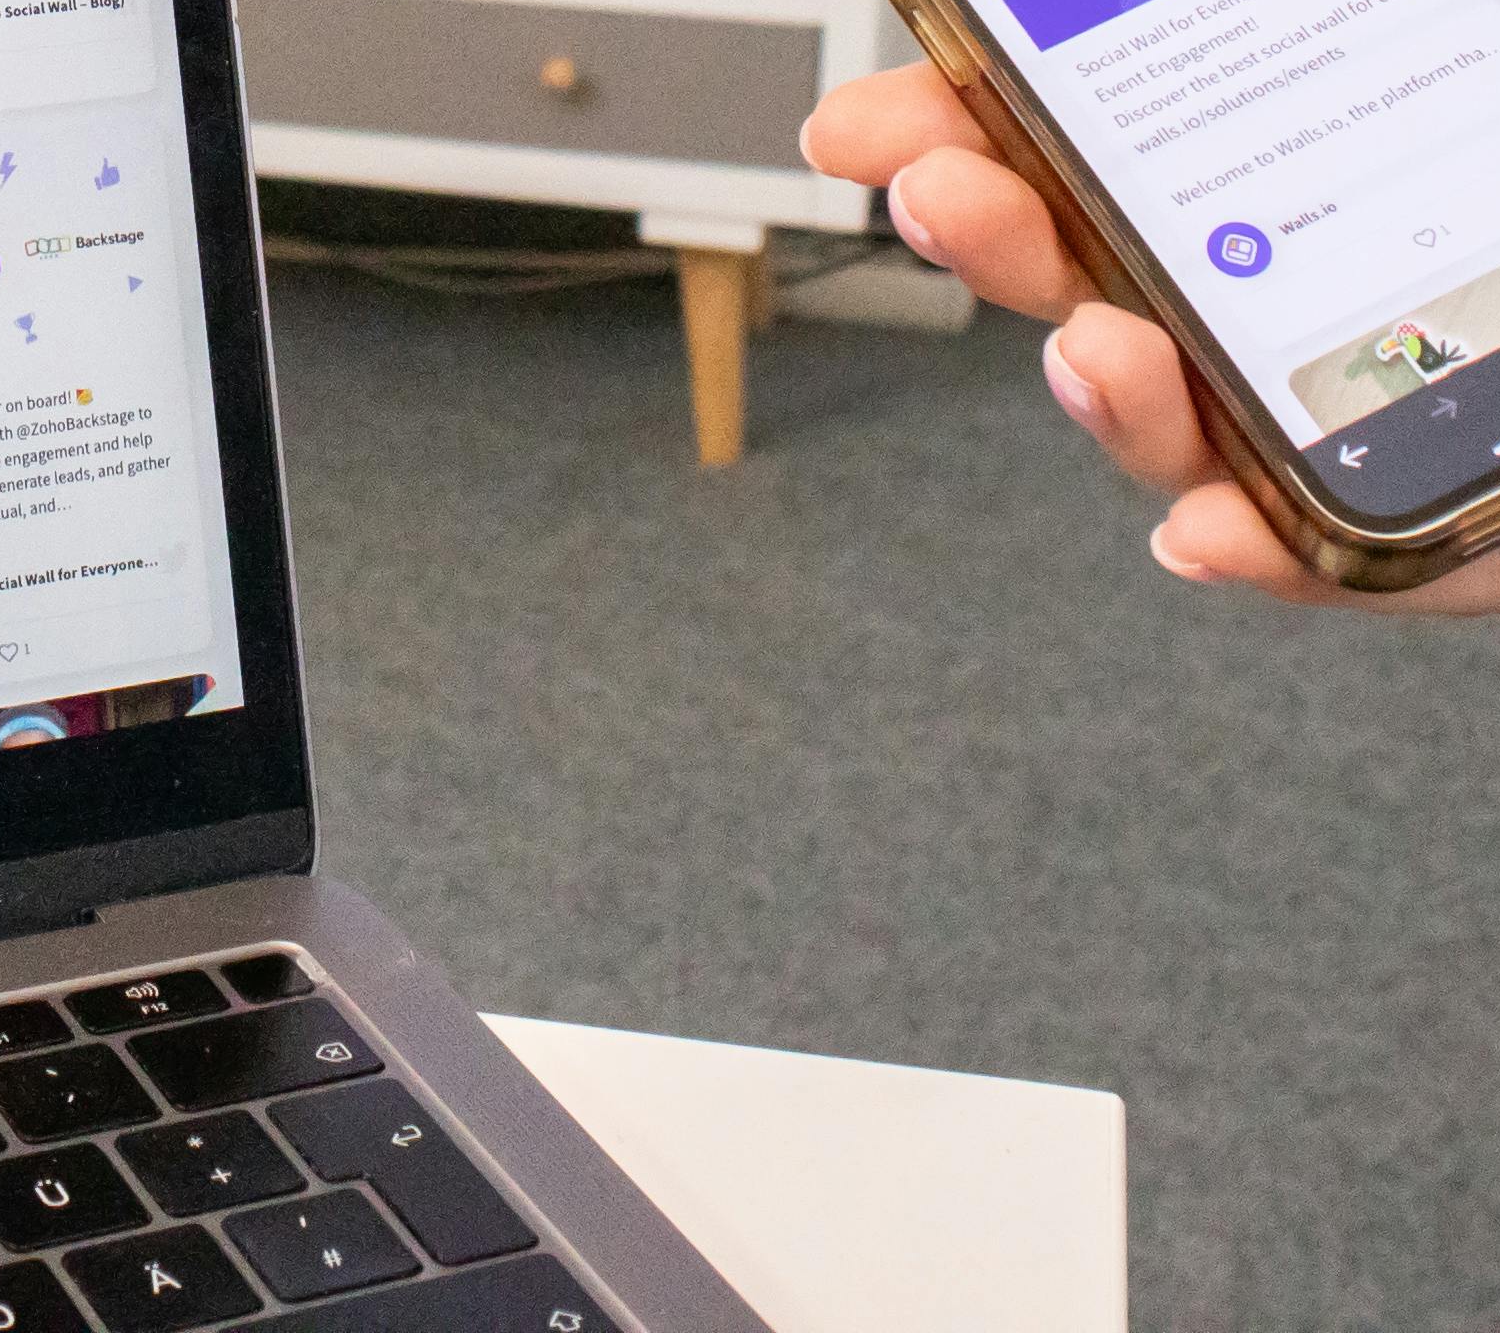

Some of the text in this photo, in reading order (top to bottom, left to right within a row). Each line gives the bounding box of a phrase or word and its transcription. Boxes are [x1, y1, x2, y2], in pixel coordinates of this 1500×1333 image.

[1075, 43, 1132, 78] Social
[1128, 23, 1171, 52] Wall
[1168, 14, 1195, 33] for
[1133, 47, 1346, 155] walls.io/solutions/events
[1278, 203, 1337, 236] Walls.io
[75, 230, 145, 249] Backstage
[5, 400, 24, 413] on
[26, 390, 72, 411] board!
[141, 1002, 170, 1015] F12
[34, 1178, 70, 1209] Ü
[323, 1248, 343, 1269] #
[144, 1260, 183, 1296] Ä
